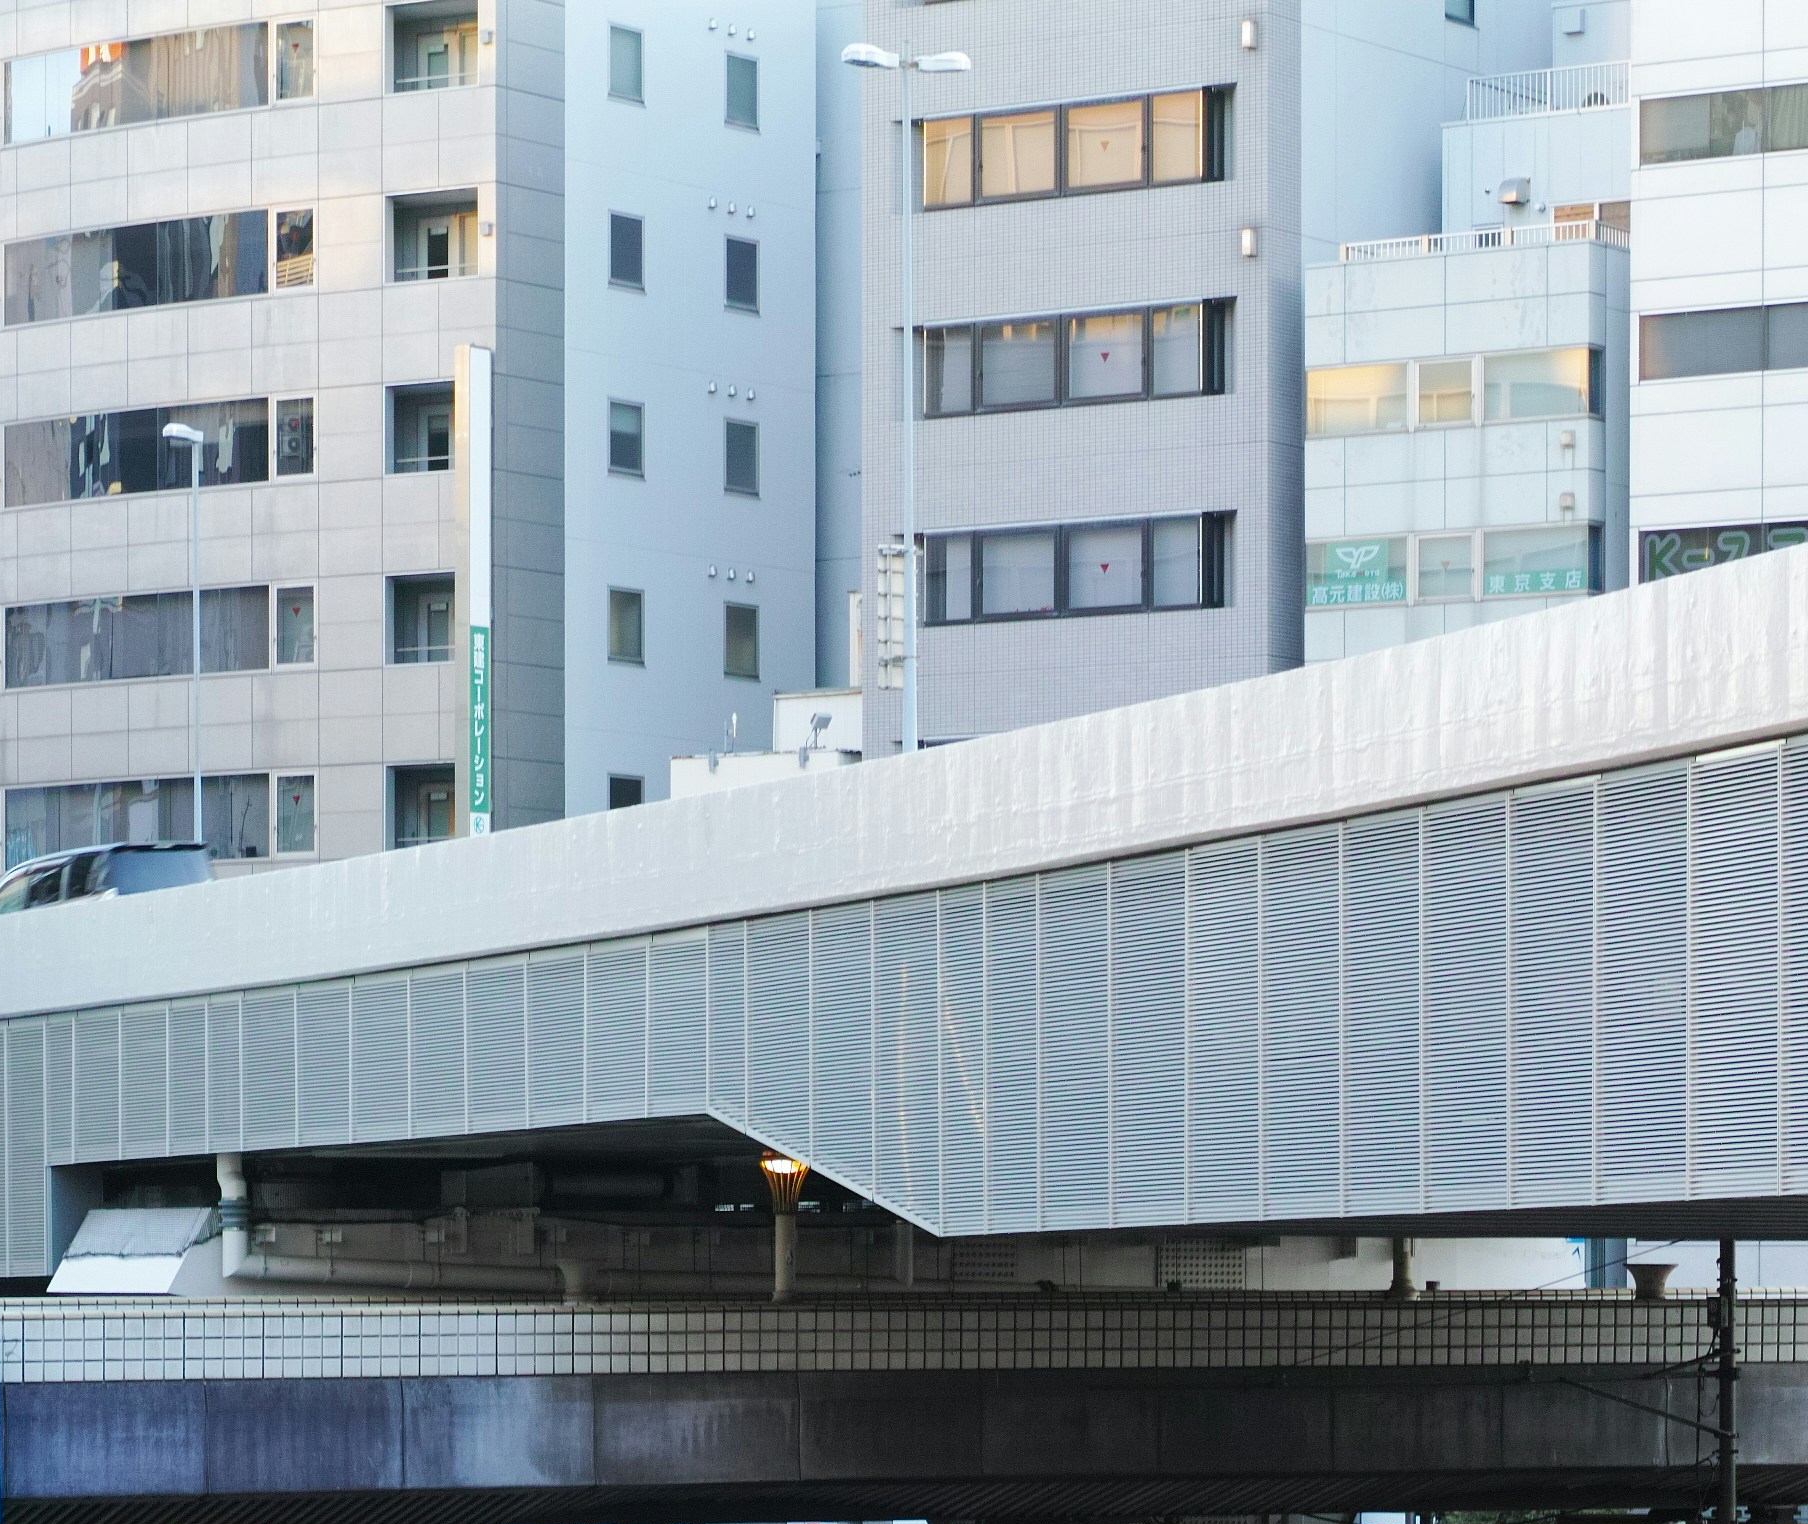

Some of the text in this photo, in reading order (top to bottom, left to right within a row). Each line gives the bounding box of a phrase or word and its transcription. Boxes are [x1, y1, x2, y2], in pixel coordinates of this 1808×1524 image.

[1489, 570, 1582, 593] 東京支店
[473, 632, 485, 806] 東建コーポレーション
